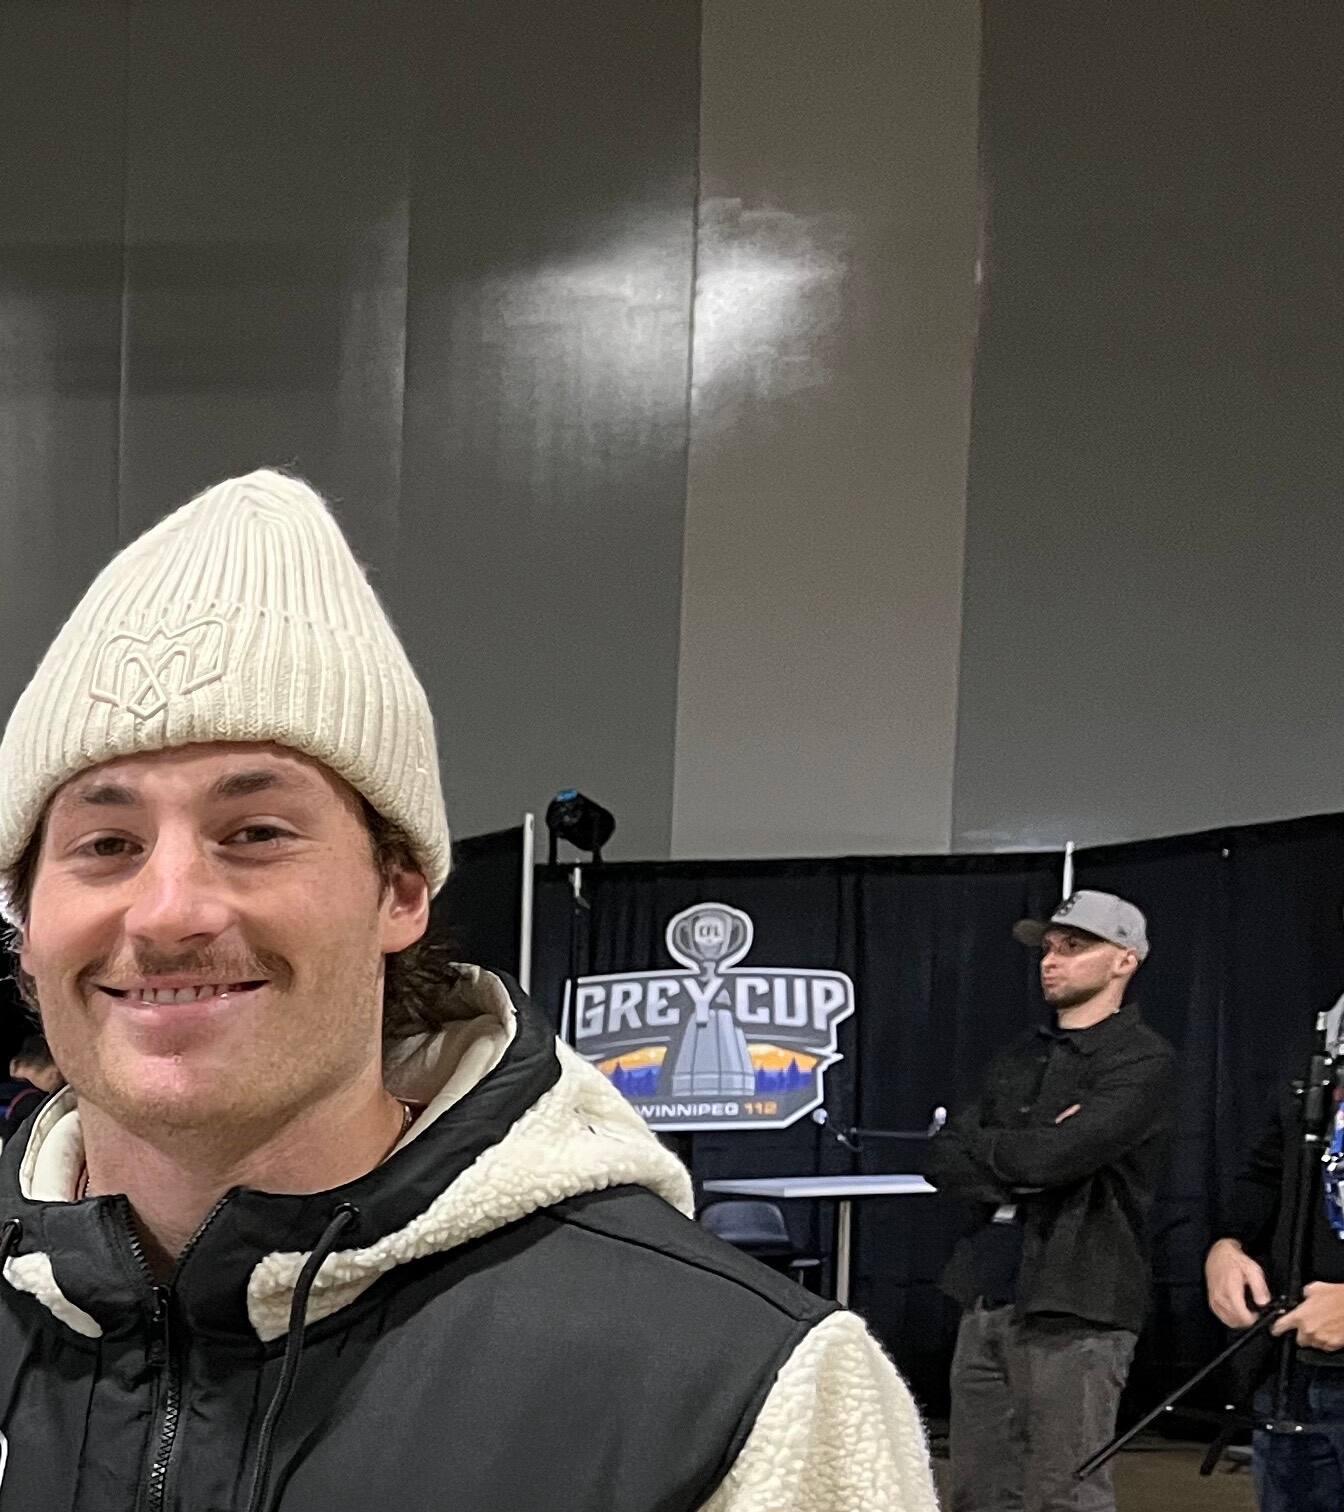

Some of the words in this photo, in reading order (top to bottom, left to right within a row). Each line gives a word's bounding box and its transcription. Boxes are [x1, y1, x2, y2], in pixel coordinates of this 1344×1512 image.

[576, 977, 725, 1040] GREY
[735, 976, 847, 1031] CUP
[635, 1101, 739, 1117] WINNIPEG
